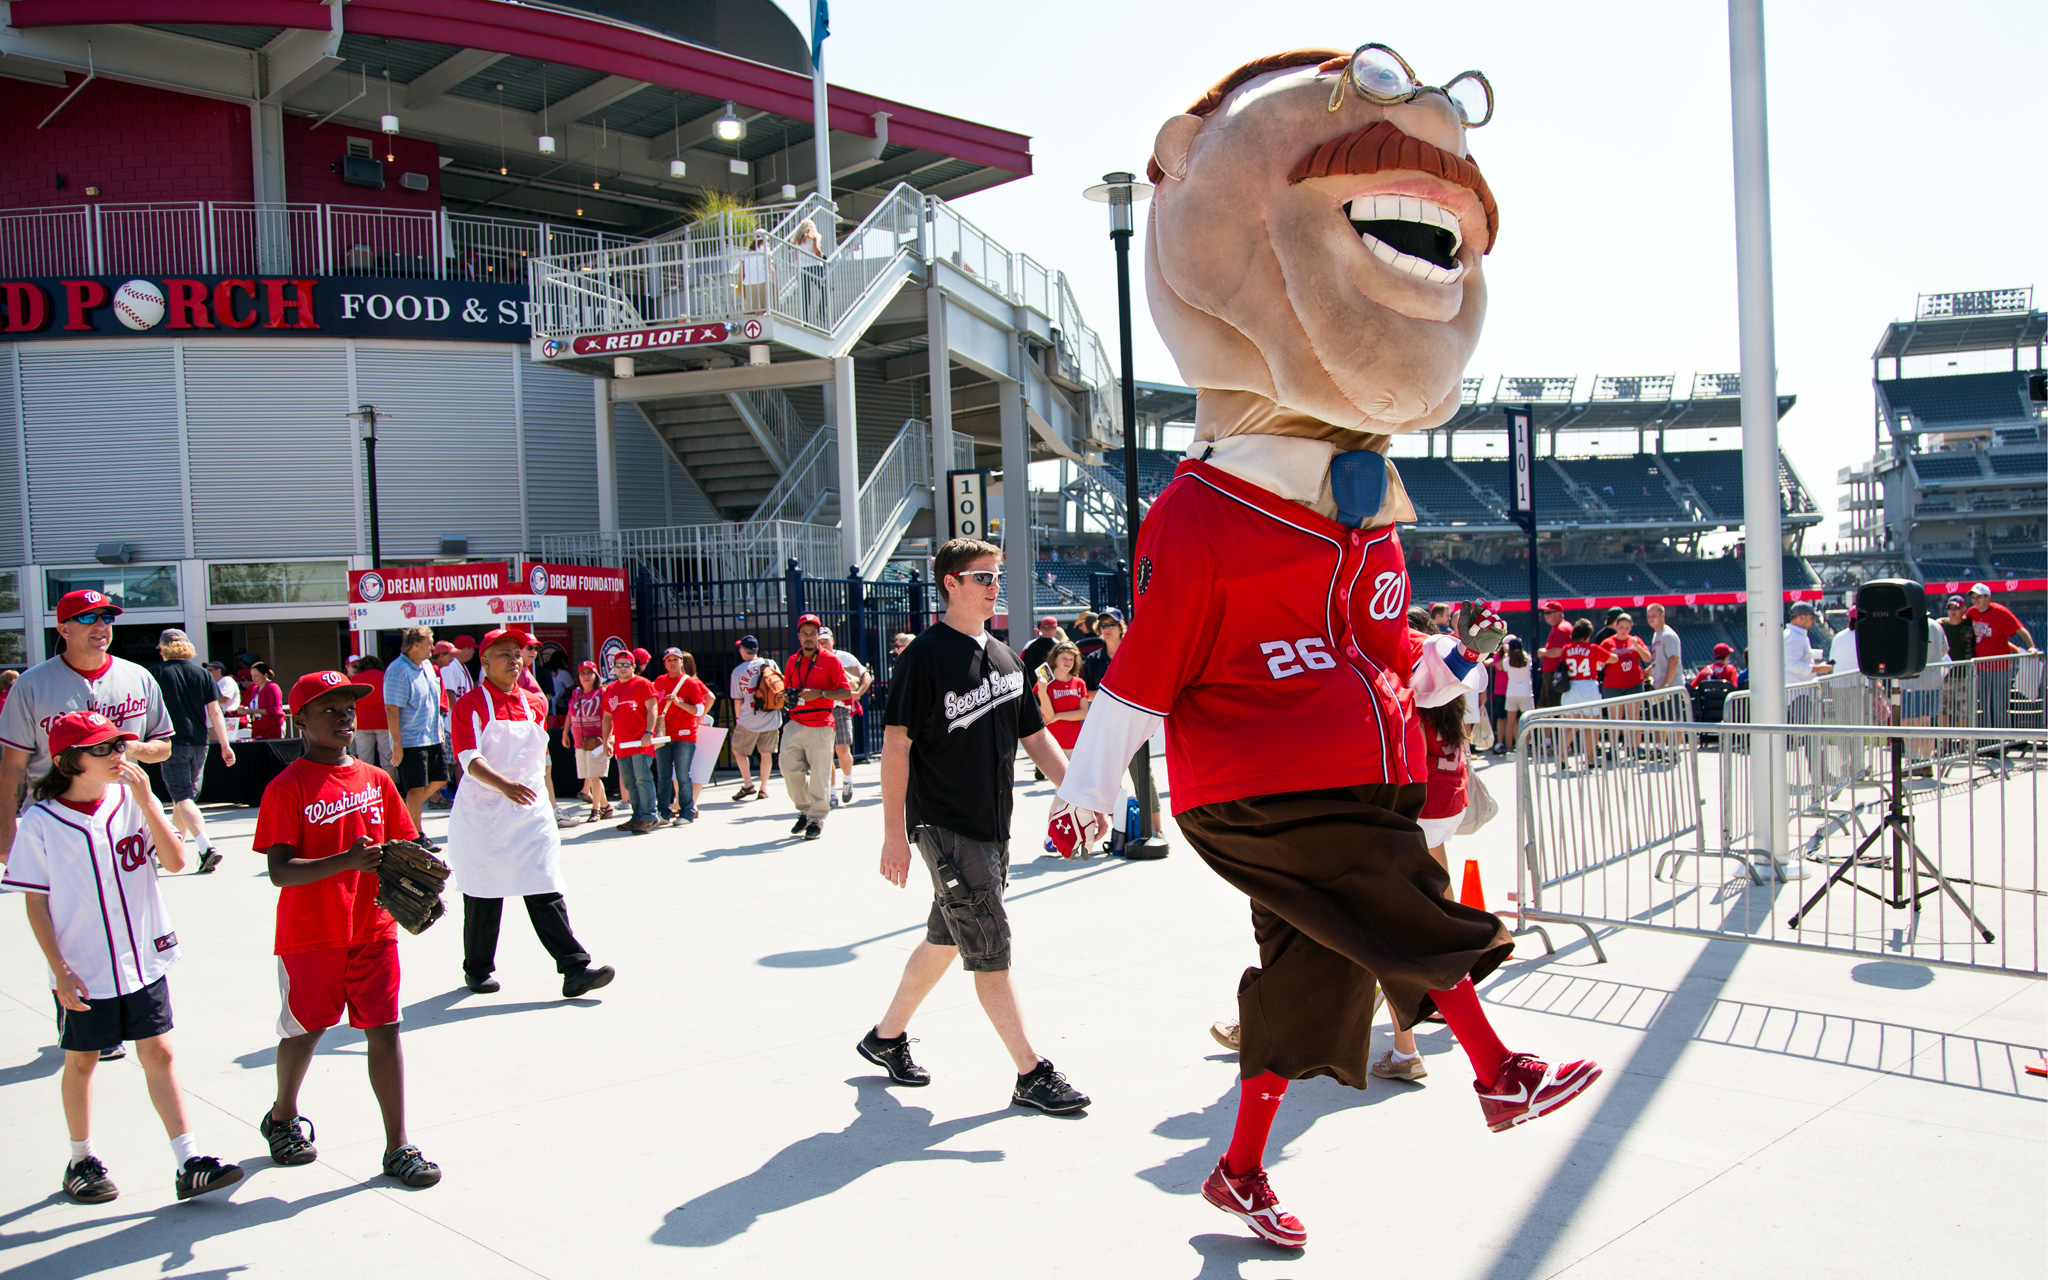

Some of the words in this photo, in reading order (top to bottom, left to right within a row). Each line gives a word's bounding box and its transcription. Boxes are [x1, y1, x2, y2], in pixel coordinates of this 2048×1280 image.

[0, 282, 48, 332] D
[340, 293, 451, 321] FOOD
[461, 298, 488, 323] &
[605, 333, 644, 350] RED
[647, 328, 695, 346] LOFT
[1517, 424, 1526, 502] 101
[960, 479, 976, 535] 100
[387, 577, 425, 594] DREAM
[428, 573, 499, 592] FOUNDATION
[550, 574, 577, 590] DREAM
[578, 575, 625, 592] FOUNDATION
[357, 608, 368, 617] $5
[445, 603, 456, 612] $5
[507, 614, 535, 622] RAFFLE
[418, 618, 445, 626] RAFFLE
[1259, 637, 1337, 680] 26
[1567, 646, 1591, 657] HARPER
[1566, 658, 1591, 677] 34
[740, 665, 762, 692] STRAS
[944, 677, 992, 720] Secret
[370, 806, 384, 825] 3
